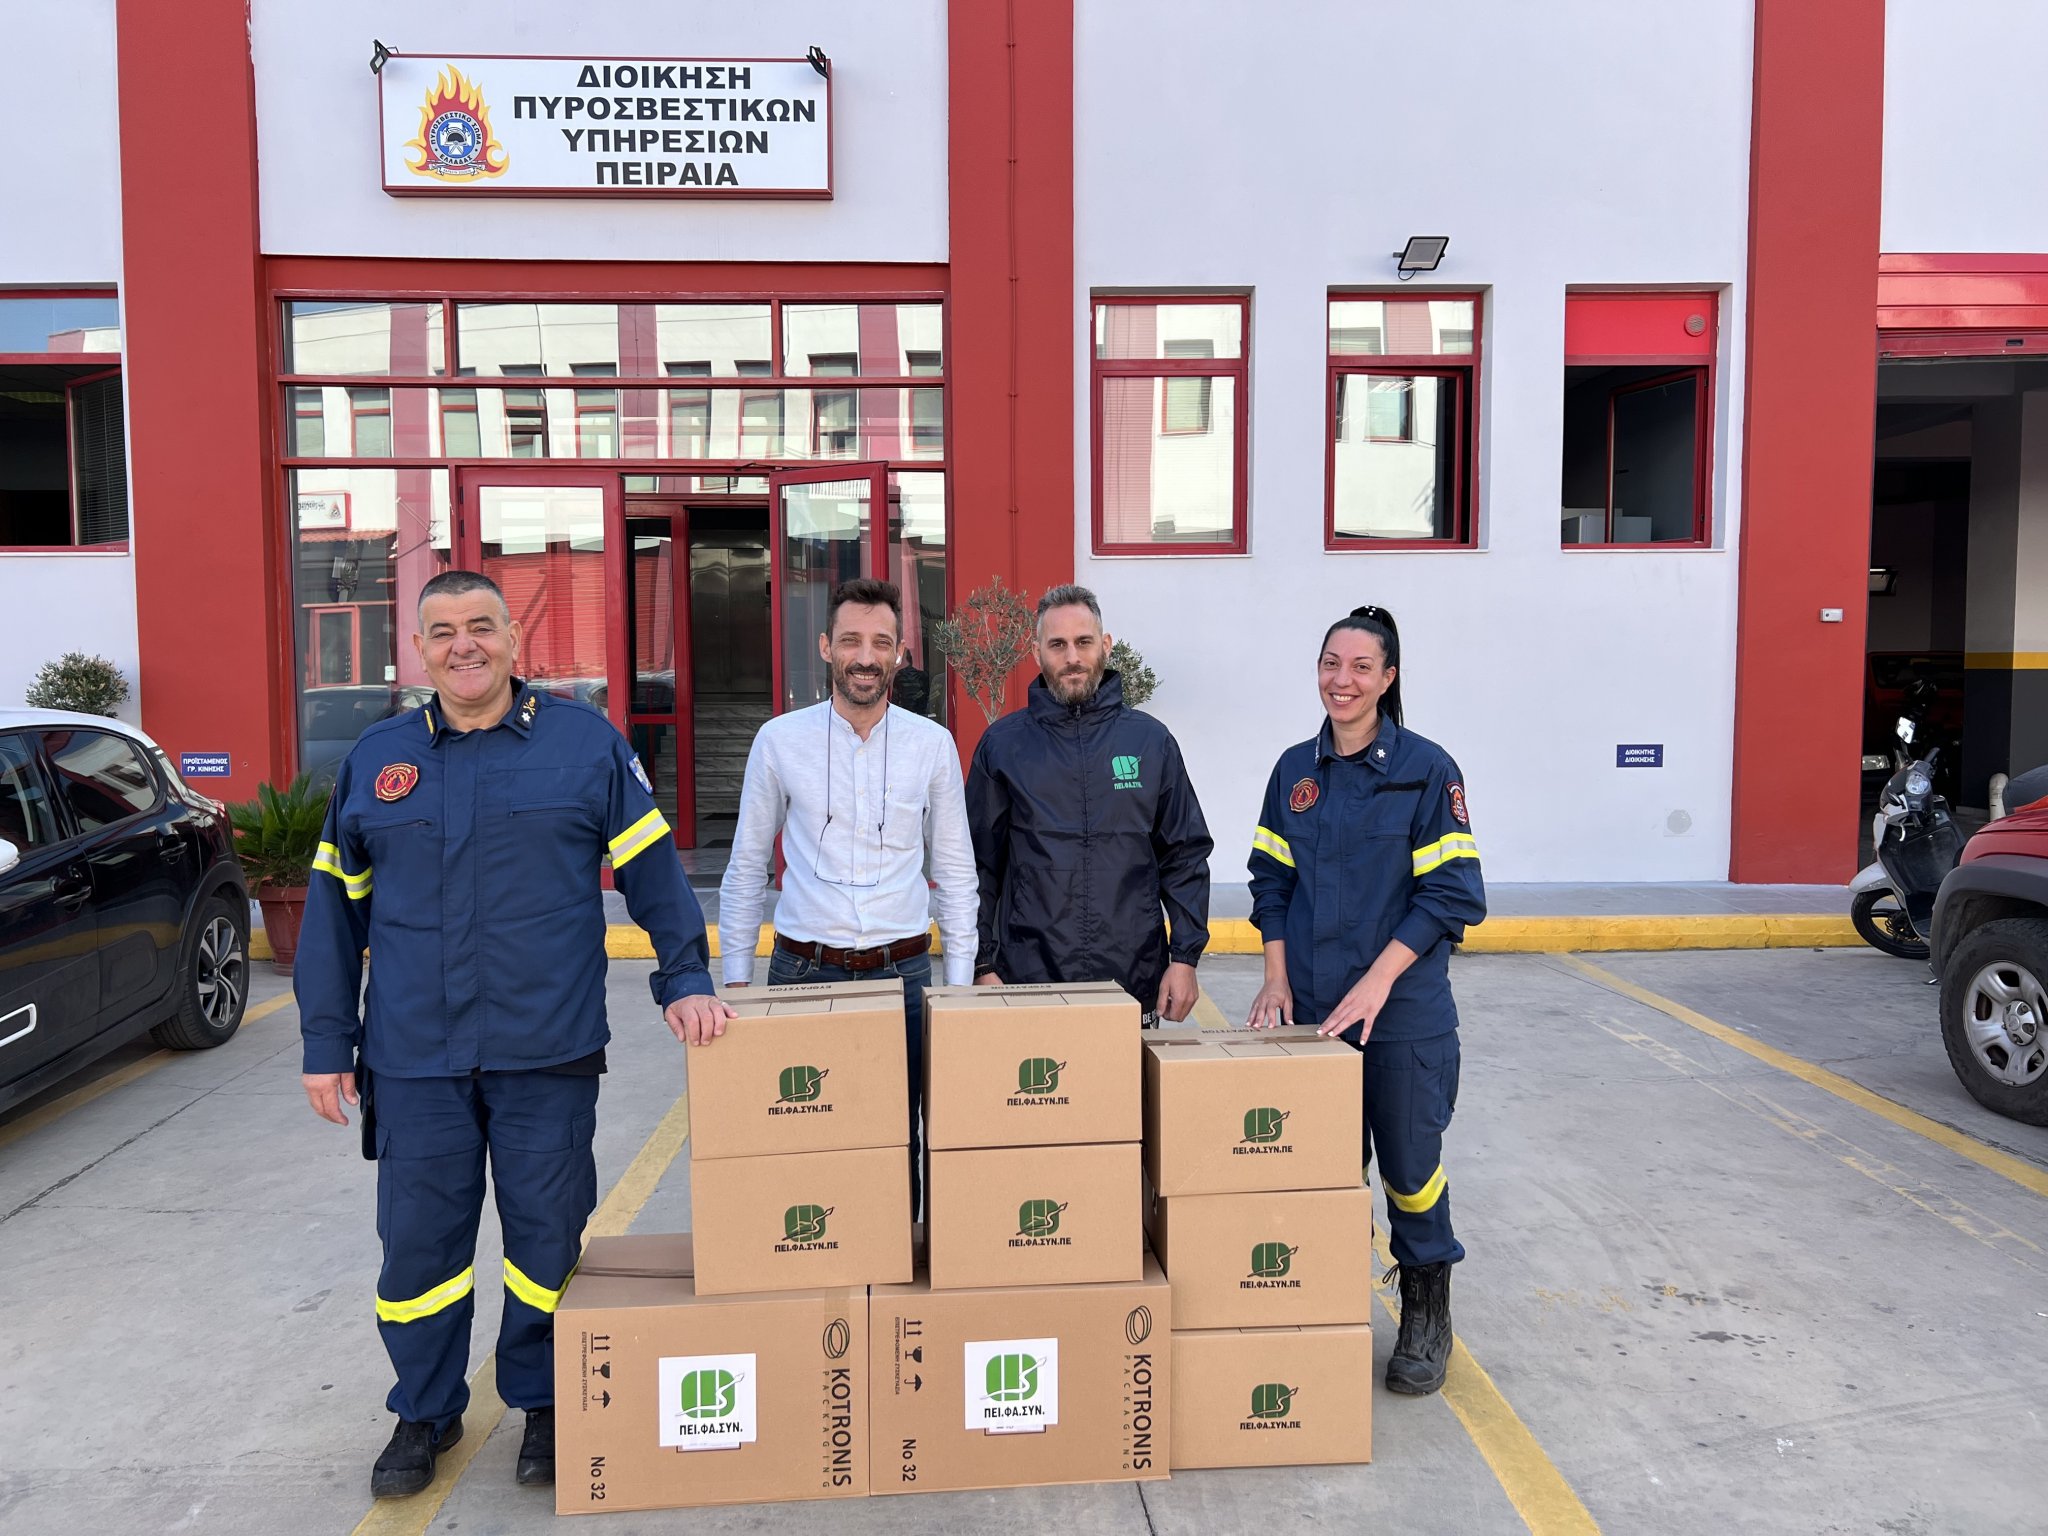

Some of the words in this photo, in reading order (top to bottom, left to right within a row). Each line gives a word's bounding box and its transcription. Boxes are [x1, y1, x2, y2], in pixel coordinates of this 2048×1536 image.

[576, 65, 751, 90] ΔΙΟΙΚΗΣΗ
[513, 95, 816, 123] ΠΥΡΟΣΒΕΣΤΙΚΩΝ
[430, 112, 472, 145] ΠΥΡΟΣΒΕΣΤΙΚΟ
[472, 122, 482, 145] ΣΩΜΑ
[561, 128, 769, 154] ΥΠΗΡΕΣΙΩΝ
[439, 153, 473, 165] ΕΛΛΑΔΑΣ
[596, 161, 739, 186] ΠΕΙΡΑΙΑ
[187, 765, 197, 773] ΓΡ.
[197, 765, 225, 773] ΚΙΝΗΣΗΣ
[768, 1104, 833, 1115] ΠΕΙ.ΦΑ.ΣΥΝ.ΠΕ
[1007, 1096, 1070, 1106] ΠΕΙ.ΦΑ.ΣΥΝ.ΠΕ
[1232, 1145, 1293, 1155] ΠΕΙ.ΦΑ.ΣΥΝ.ΠΕ
[774, 1241, 839, 1253] ΠΕΙ.ΦΑ.ΣΥΝ.ΠΕ
[1008, 1237, 1072, 1248] ΠΕΙ.ΦΑ.ΣΥΝ.ΠΕ
[1239, 1280, 1302, 1289] ΠΕΙ.ΦΑ.ΣΥΝ.ΠΕ
[984, 1404, 1045, 1419] ΠΕΙ.ΦΑ.ΣΥΝ.
[1122, 1354, 1131, 1470] PACKAGING
[1133, 1354, 1152, 1470] KOTRONIS
[679, 1422, 743, 1435] ΠΕΙ.ΦΑ.ΣΥΝ.
[822, 1370, 830, 1488] PACKAGING
[831, 1368, 852, 1487] KOTRONIS
[1239, 1421, 1302, 1430] ΠΕΙ.ΦΑ.ΣΥΝ.ΠΕ
[902, 1439, 917, 1460] No
[590, 1456, 606, 1478] No
[902, 1464, 917, 1482] 32
[590, 1482, 606, 1501] 32
